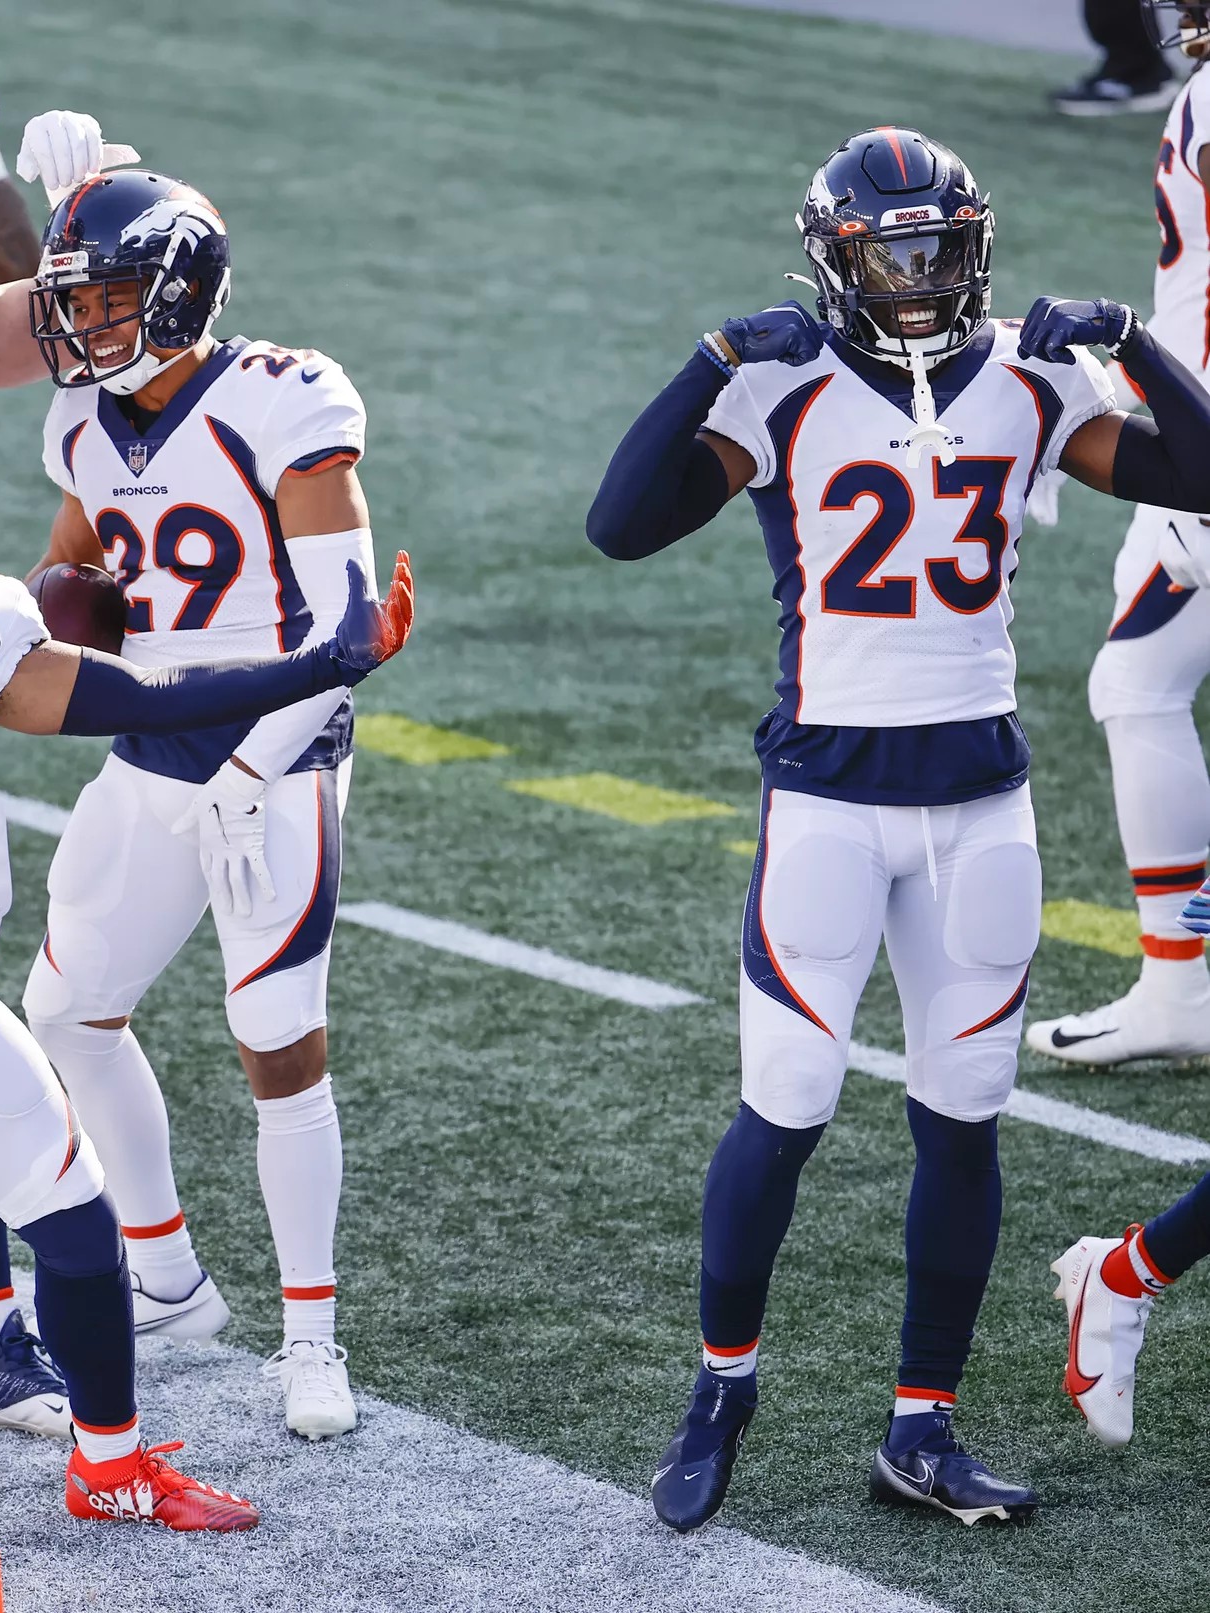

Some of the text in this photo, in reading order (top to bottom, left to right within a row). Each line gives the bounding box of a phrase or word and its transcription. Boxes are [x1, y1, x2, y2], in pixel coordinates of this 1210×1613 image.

[895, 210, 930, 222] BRONCOS
[112, 486, 168, 496] BRONCOS
[94, 502, 246, 635] 29
[819, 456, 1018, 619] 23
